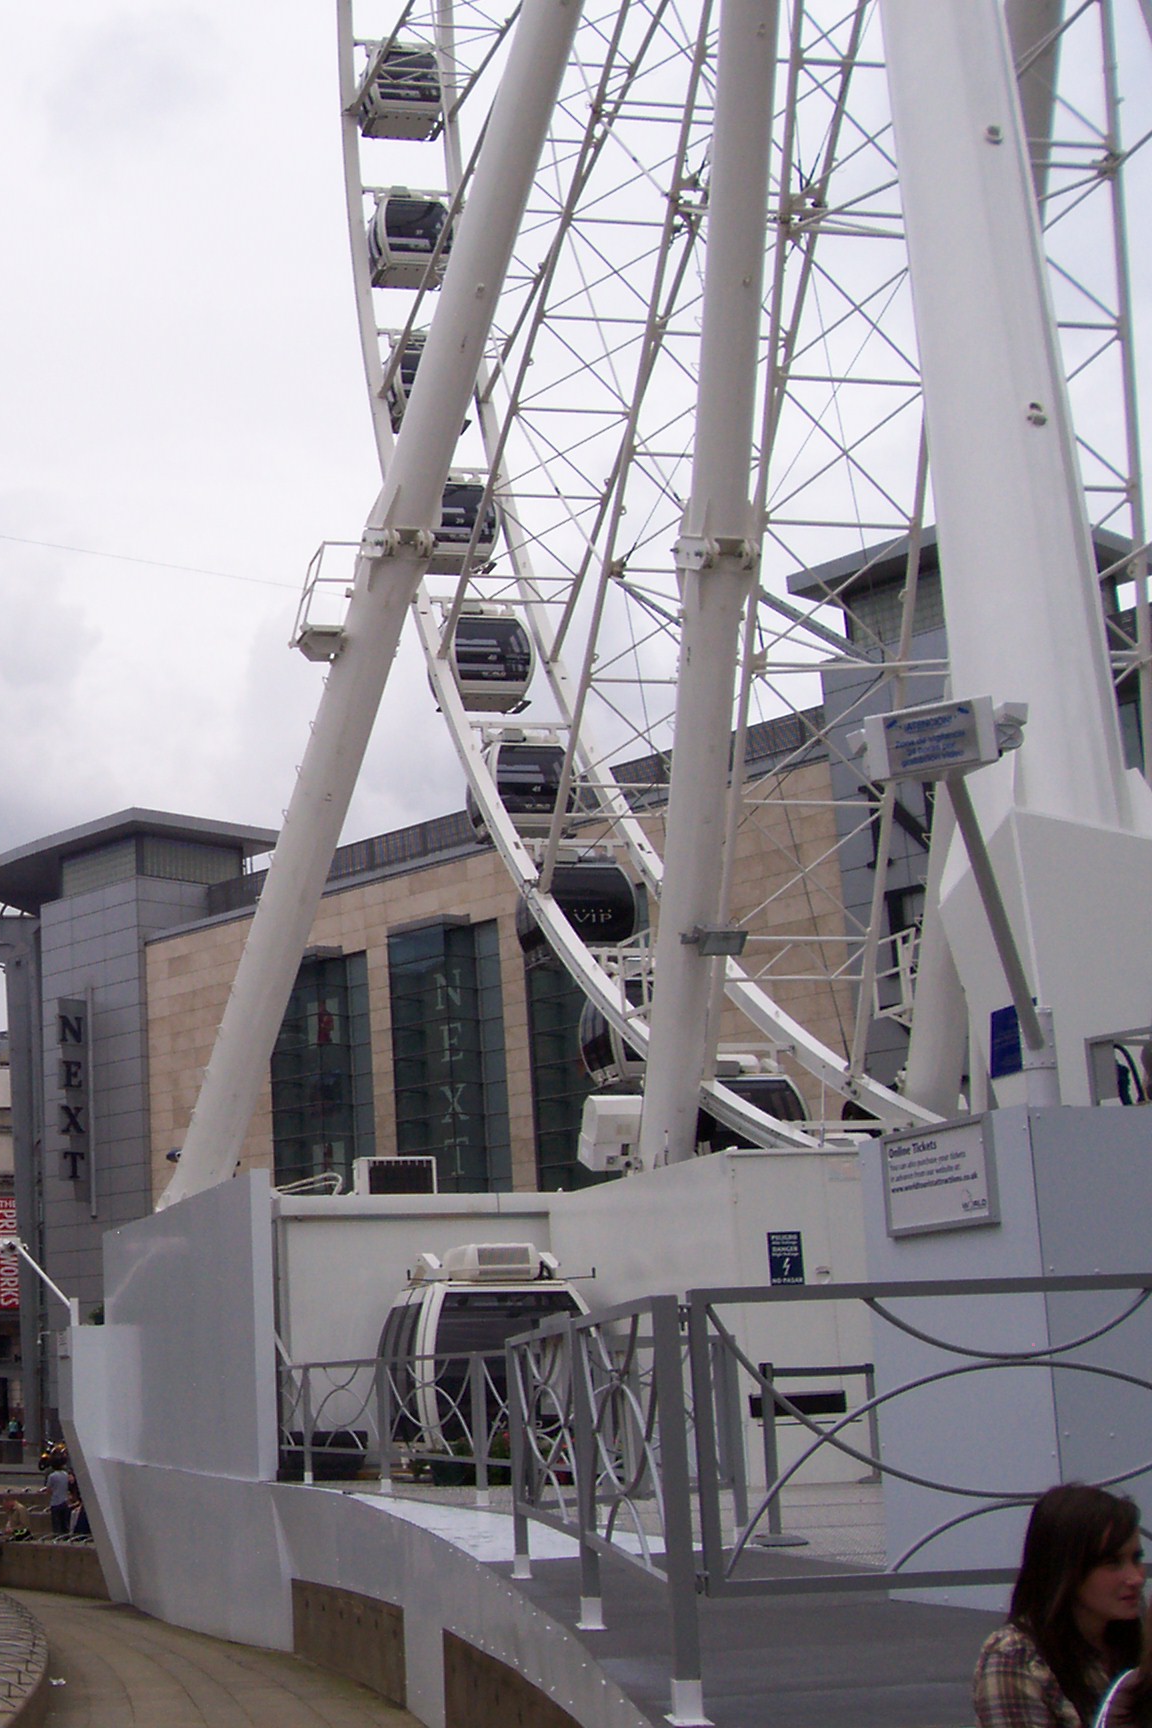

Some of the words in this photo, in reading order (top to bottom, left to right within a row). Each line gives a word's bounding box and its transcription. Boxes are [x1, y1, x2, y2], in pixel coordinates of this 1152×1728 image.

[574, 912, 612, 924] VIP
[58, 1014, 85, 1179] NEXT
[433, 968, 470, 1176] NEXT
[888, 1146, 911, 1159] Online
[912, 1140, 937, 1154] Tickets
[0, 1200, 16, 1208] THE
[0, 1209, 19, 1306] PRIWORKS
